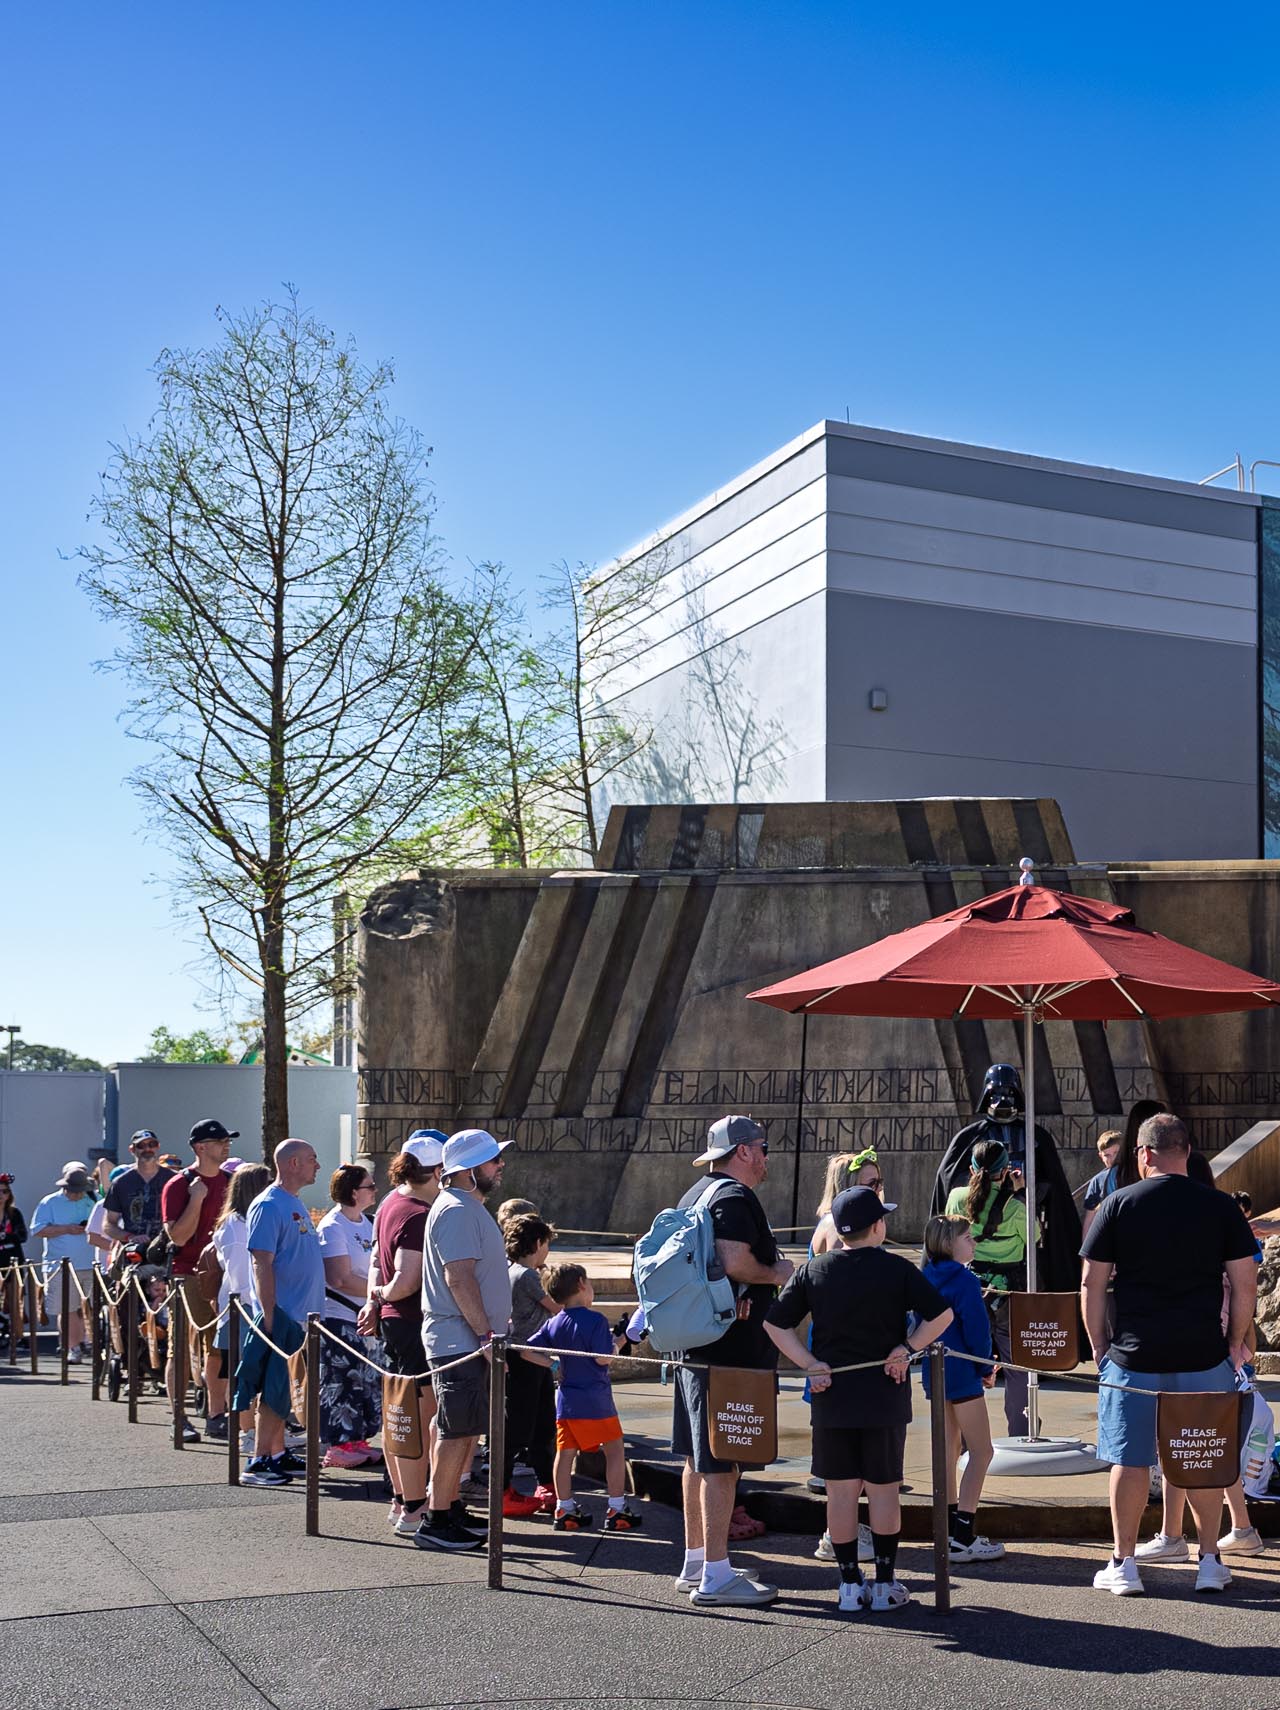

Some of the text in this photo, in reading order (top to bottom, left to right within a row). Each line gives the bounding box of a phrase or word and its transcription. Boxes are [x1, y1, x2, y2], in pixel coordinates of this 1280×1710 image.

[1029, 1322, 1058, 1330] PLEASE
[1051, 1331, 1068, 1339] OFF
[726, 1402, 754, 1412] PLEASE
[717, 1412, 765, 1424] REMAIN OFF
[399, 1425, 412, 1433] AND
[719, 1423, 762, 1435] STEPS AND
[1181, 1429, 1217, 1437] PLEASE
[727, 1435, 753, 1446] STAGE
[1169, 1438, 1227, 1448] REMAIN OFF
[1171, 1449, 1224, 1459] STEPS AND
[1183, 1460, 1213, 1470] STAGE
